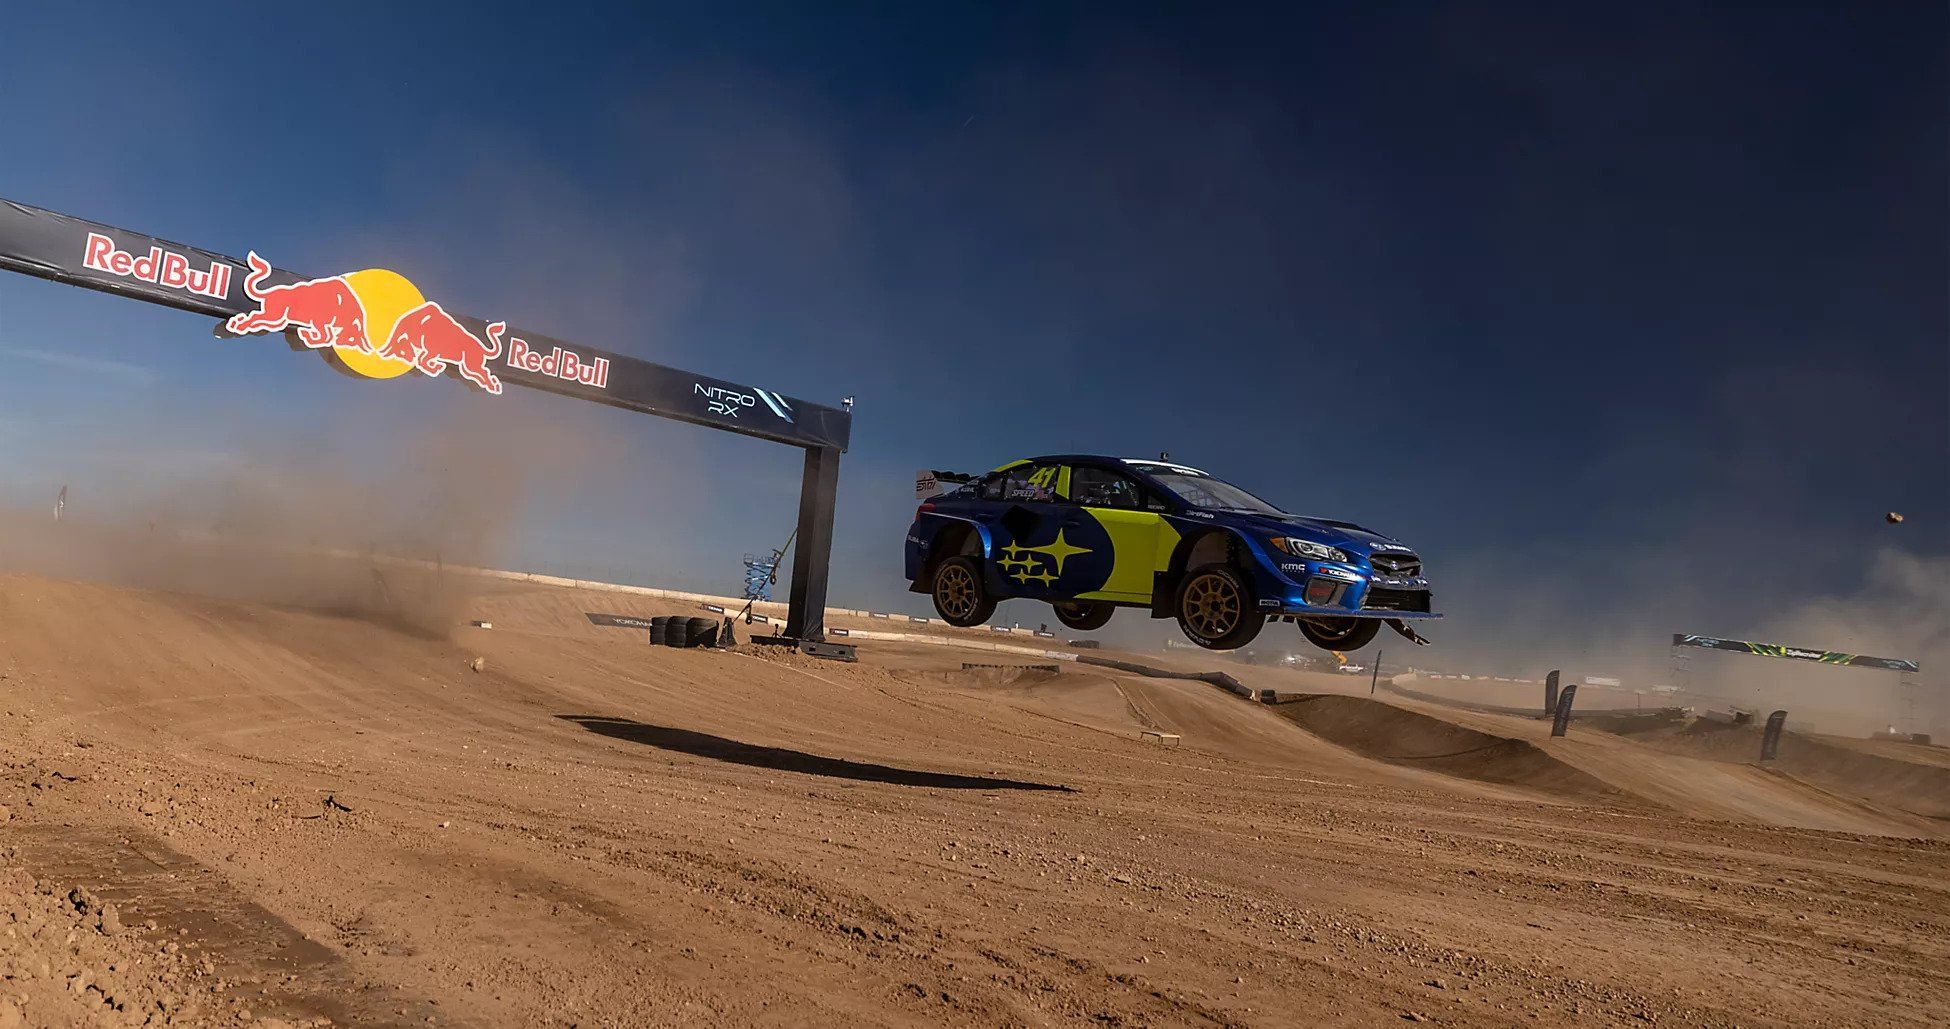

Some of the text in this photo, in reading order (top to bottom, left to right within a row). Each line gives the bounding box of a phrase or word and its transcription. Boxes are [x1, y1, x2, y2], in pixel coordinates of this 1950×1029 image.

[83, 232, 233, 300] Red Bull
[507, 337, 610, 389] Red Bull
[694, 382, 756, 408] NITRO
[708, 400, 740, 419] RX
[1028, 467, 1056, 489] 41
[1011, 488, 1036, 498] SPEED
